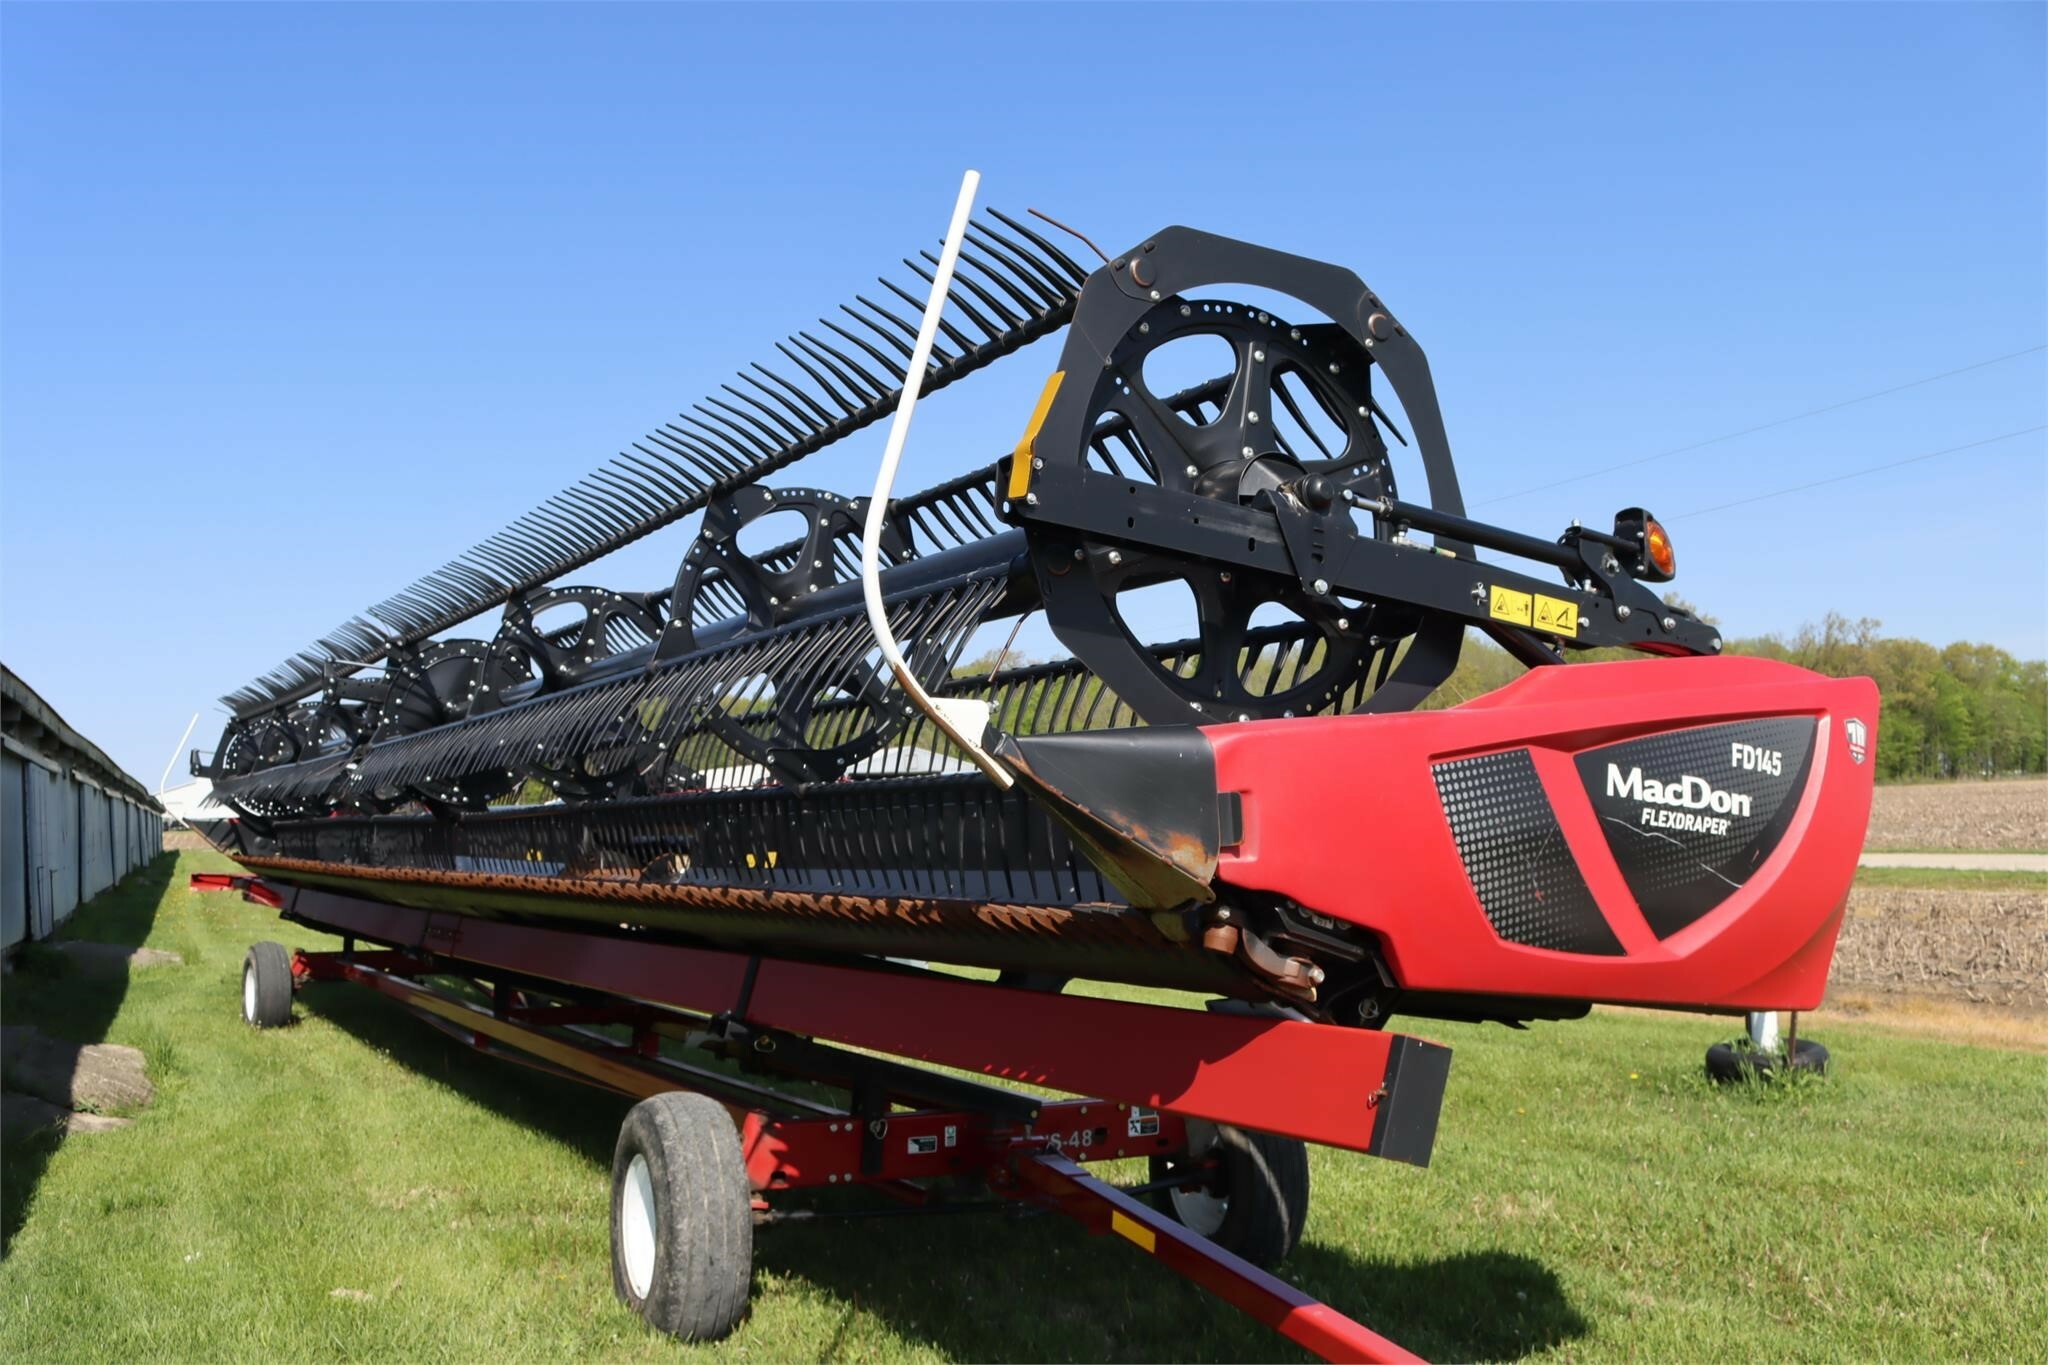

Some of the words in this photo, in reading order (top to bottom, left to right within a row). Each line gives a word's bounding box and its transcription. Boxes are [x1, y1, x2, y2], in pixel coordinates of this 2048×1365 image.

[1731, 742, 1782, 777] FD145
[1607, 763, 1752, 817] MacDon
[1641, 808, 1730, 836] FLEXDRAPER
[1046, 1129, 1092, 1150] S-48
